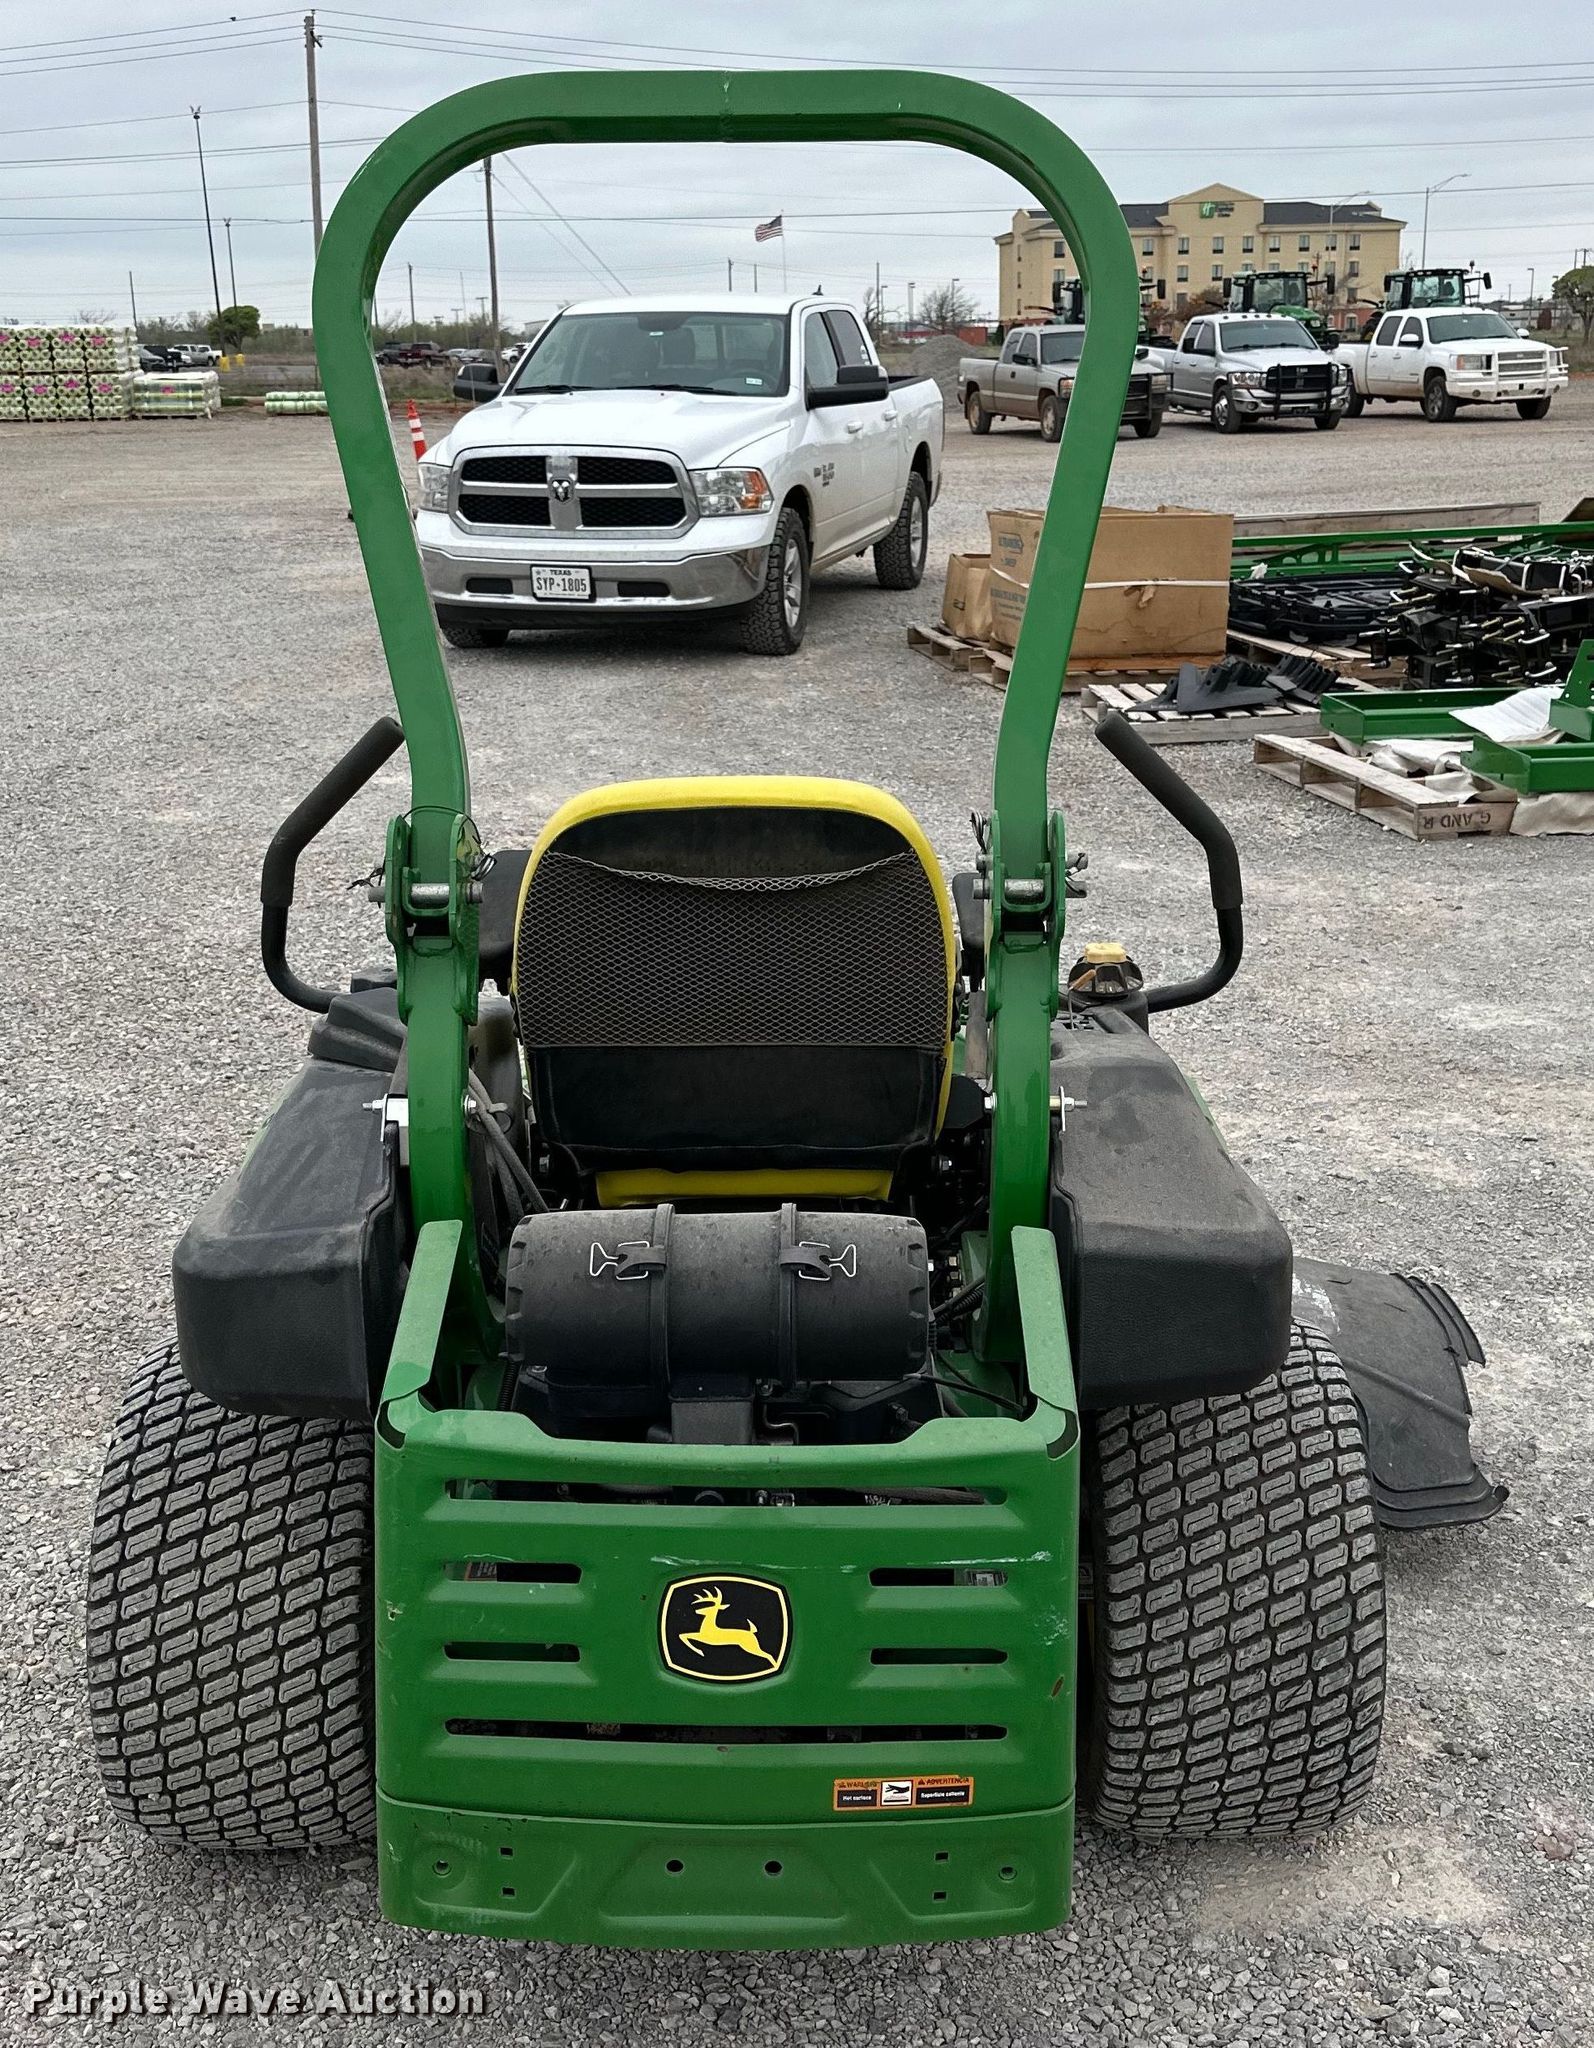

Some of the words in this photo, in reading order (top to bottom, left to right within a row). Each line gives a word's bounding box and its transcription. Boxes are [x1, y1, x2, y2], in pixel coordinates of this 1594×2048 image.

[1423, 816, 1434, 830] R
[1440, 813, 1473, 828] AND
[1480, 811, 1491, 825] G
